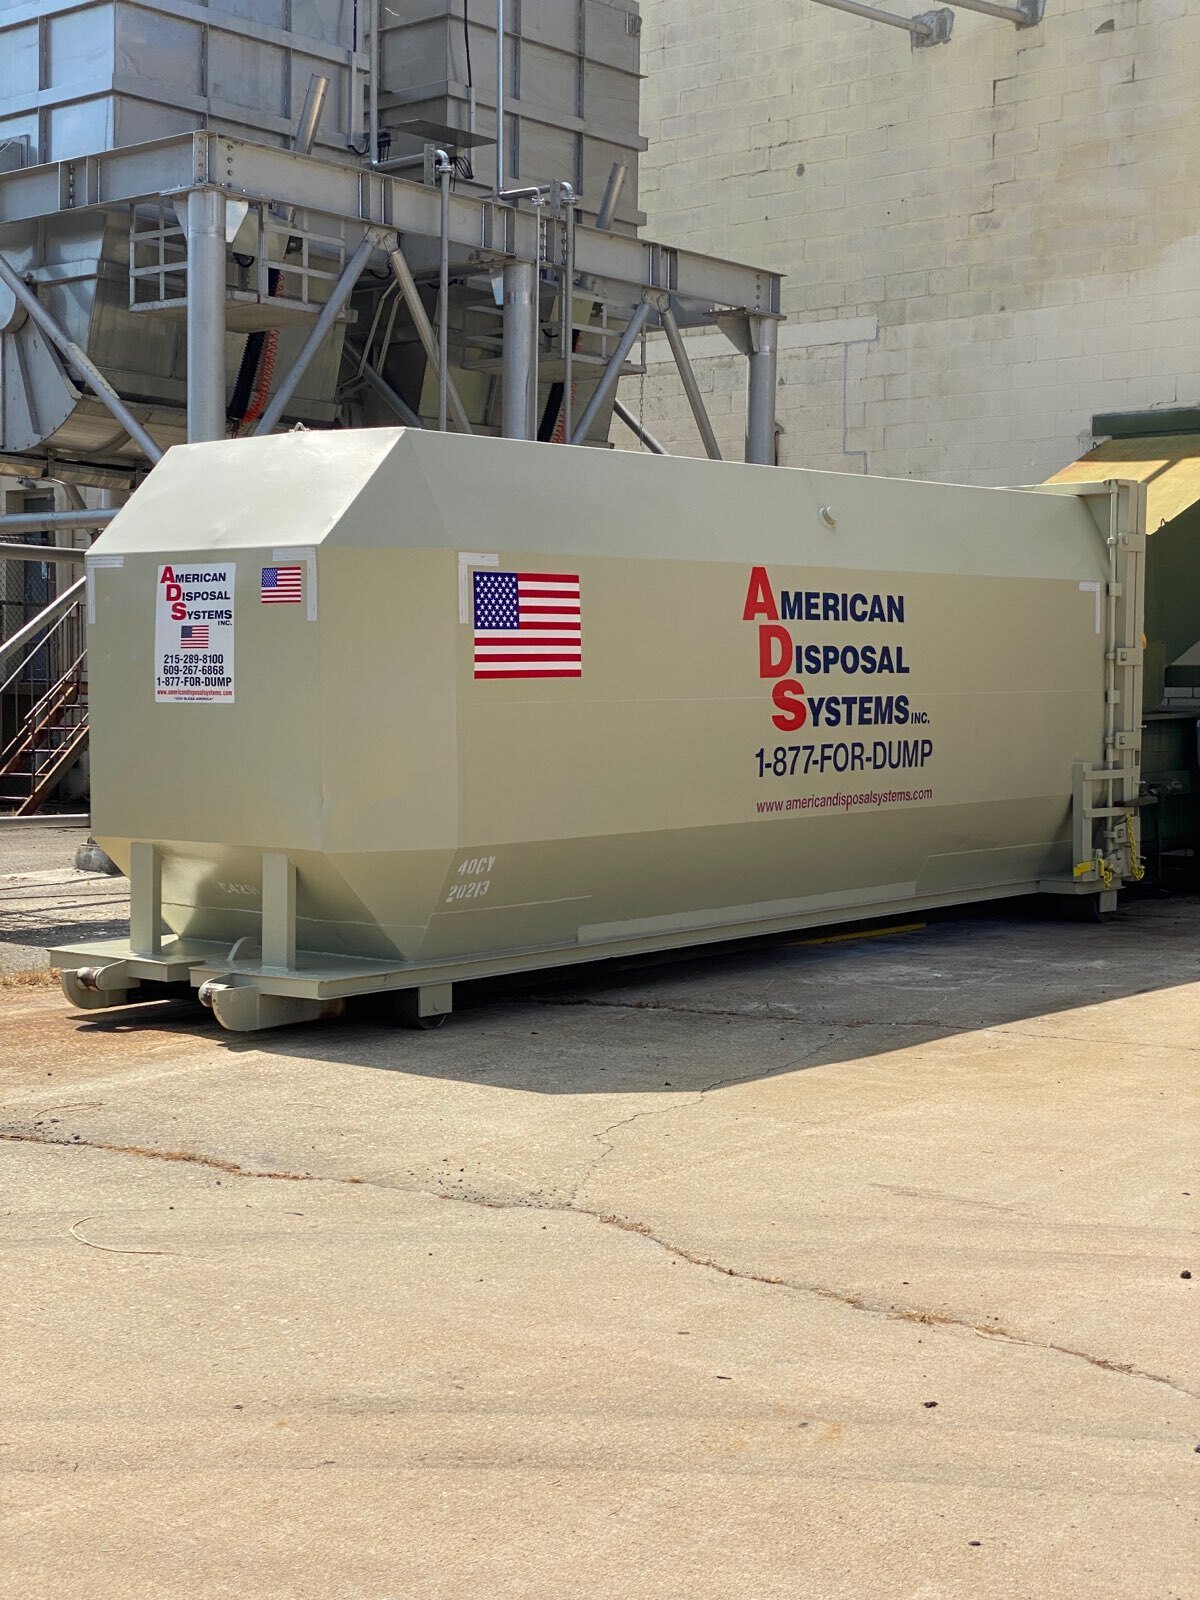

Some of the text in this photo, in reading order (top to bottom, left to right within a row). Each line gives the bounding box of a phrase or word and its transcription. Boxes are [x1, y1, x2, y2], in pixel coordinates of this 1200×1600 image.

[160, 566, 226, 583] AMERICAN
[166, 584, 231, 601] DISPOSAL
[743, 566, 905, 623] AMERICAN
[171, 602, 233, 621] SYSTEMS
[163, 654, 224, 664] 215-289-8100
[758, 624, 910, 679] DISPOSAL
[163, 665, 225, 675] 609-267-6868
[156, 677, 232, 687] 1-877-FOR-DUMP
[771, 678, 931, 732] SYSTEMS INC.
[754, 739, 933, 778] 1-877-FOR-DUMP
[457, 855, 496, 875] 40CY
[445, 880, 490, 903] 20213
